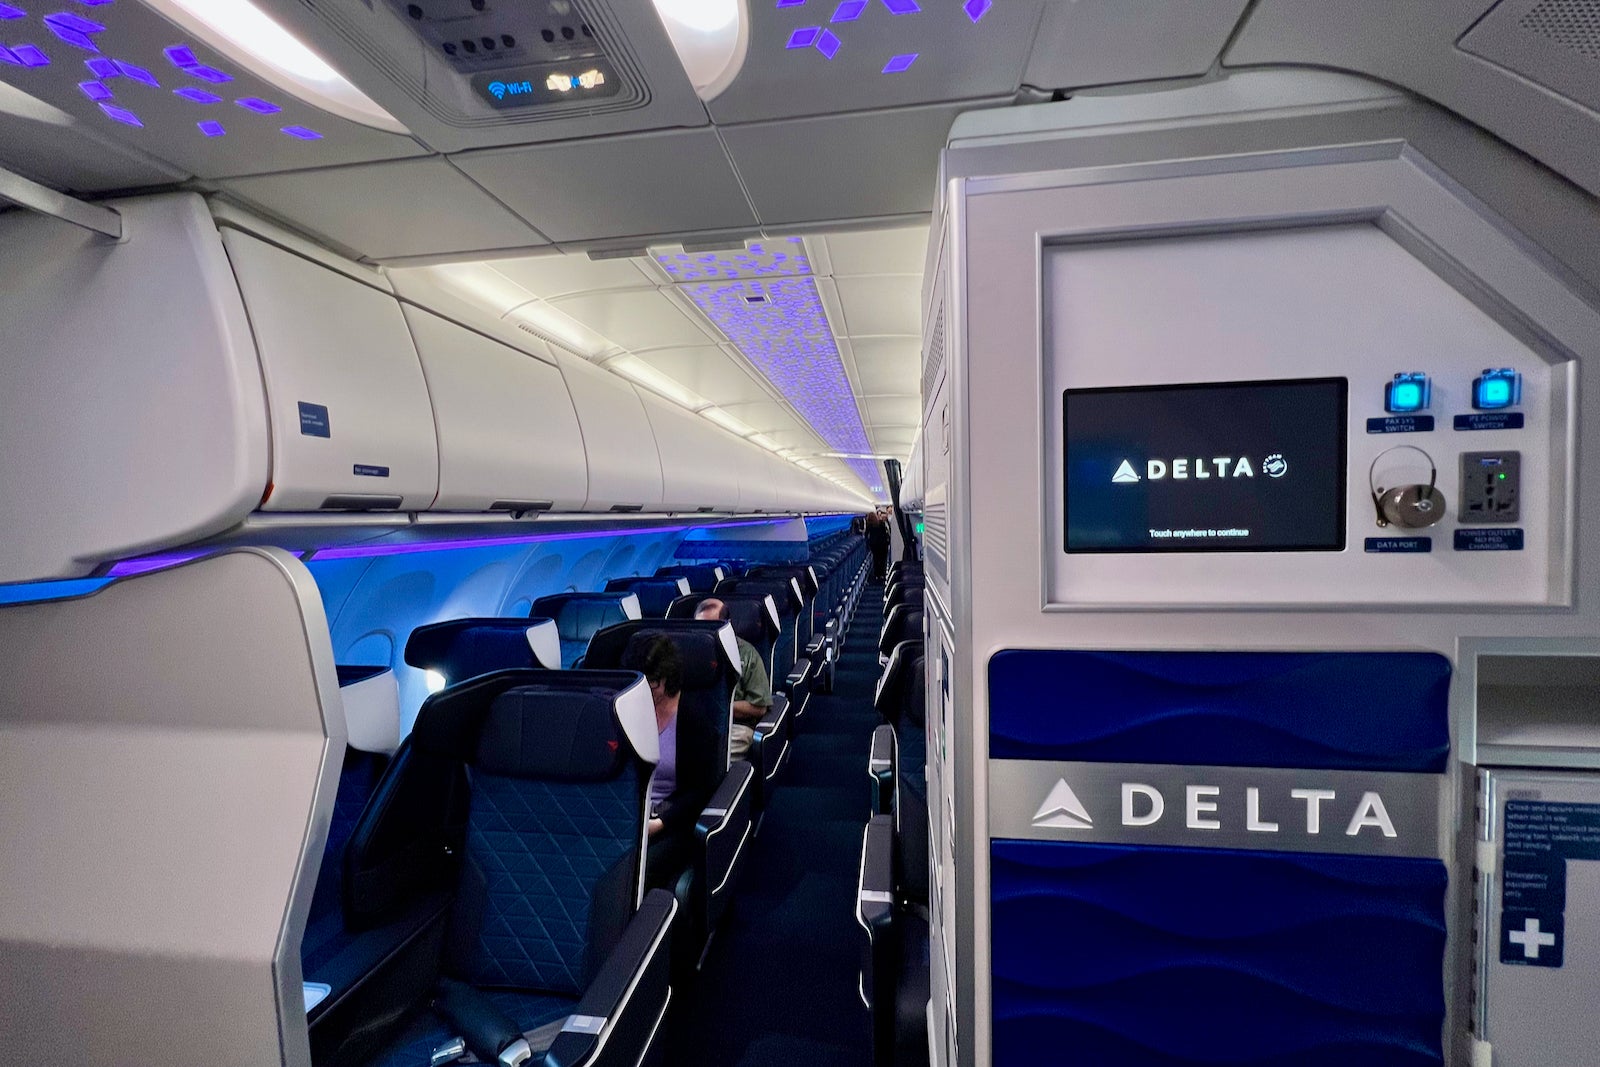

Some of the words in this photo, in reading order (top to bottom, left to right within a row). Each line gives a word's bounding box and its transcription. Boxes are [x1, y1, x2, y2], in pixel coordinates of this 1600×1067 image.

[507, 81, 532, 95] Wi-Fi
[1147, 457, 1254, 480] DELTA
[1149, 529, 1172, 537] Touch
[1173, 529, 1207, 539] anywhere
[1208, 529, 1217, 537] to
[1217, 528, 1249, 537] continue
[1376, 541, 1397, 549] DATA
[1399, 541, 1418, 549] PORT
[1121, 782, 1398, 838] DELTA
